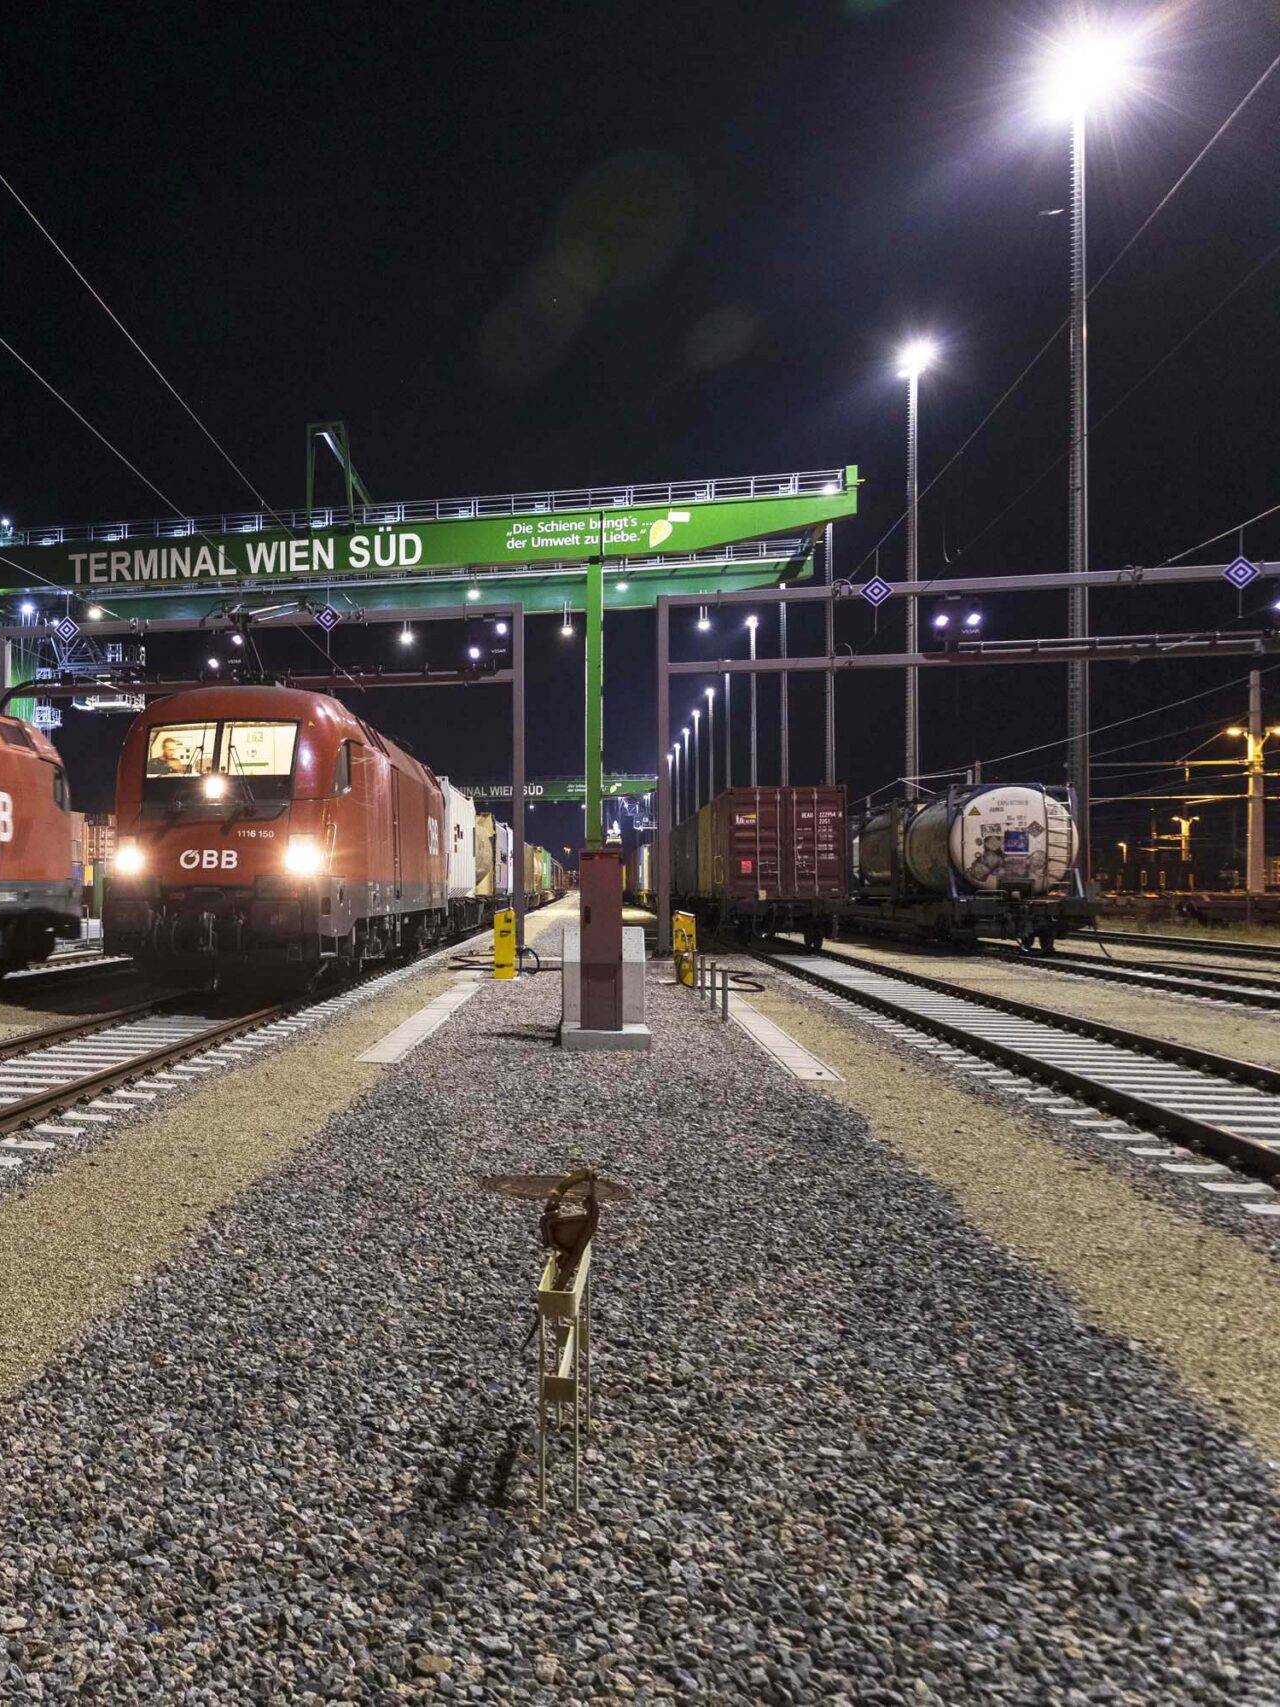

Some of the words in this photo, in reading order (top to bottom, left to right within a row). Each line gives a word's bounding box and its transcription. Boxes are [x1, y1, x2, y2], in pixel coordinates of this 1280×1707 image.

[537, 520, 586, 533] Schiene
[506, 536, 528, 549] der
[531, 533, 581, 548] Umwelt
[584, 534, 600, 545] zu
[68, 545, 237, 584] TERMINAL
[246, 537, 335, 575] WIEN
[348, 526, 423, 569] SÜD
[237, 829, 257, 838] 1116
[258, 829, 275, 838] 150
[179, 849, 238, 870] ÖBB
